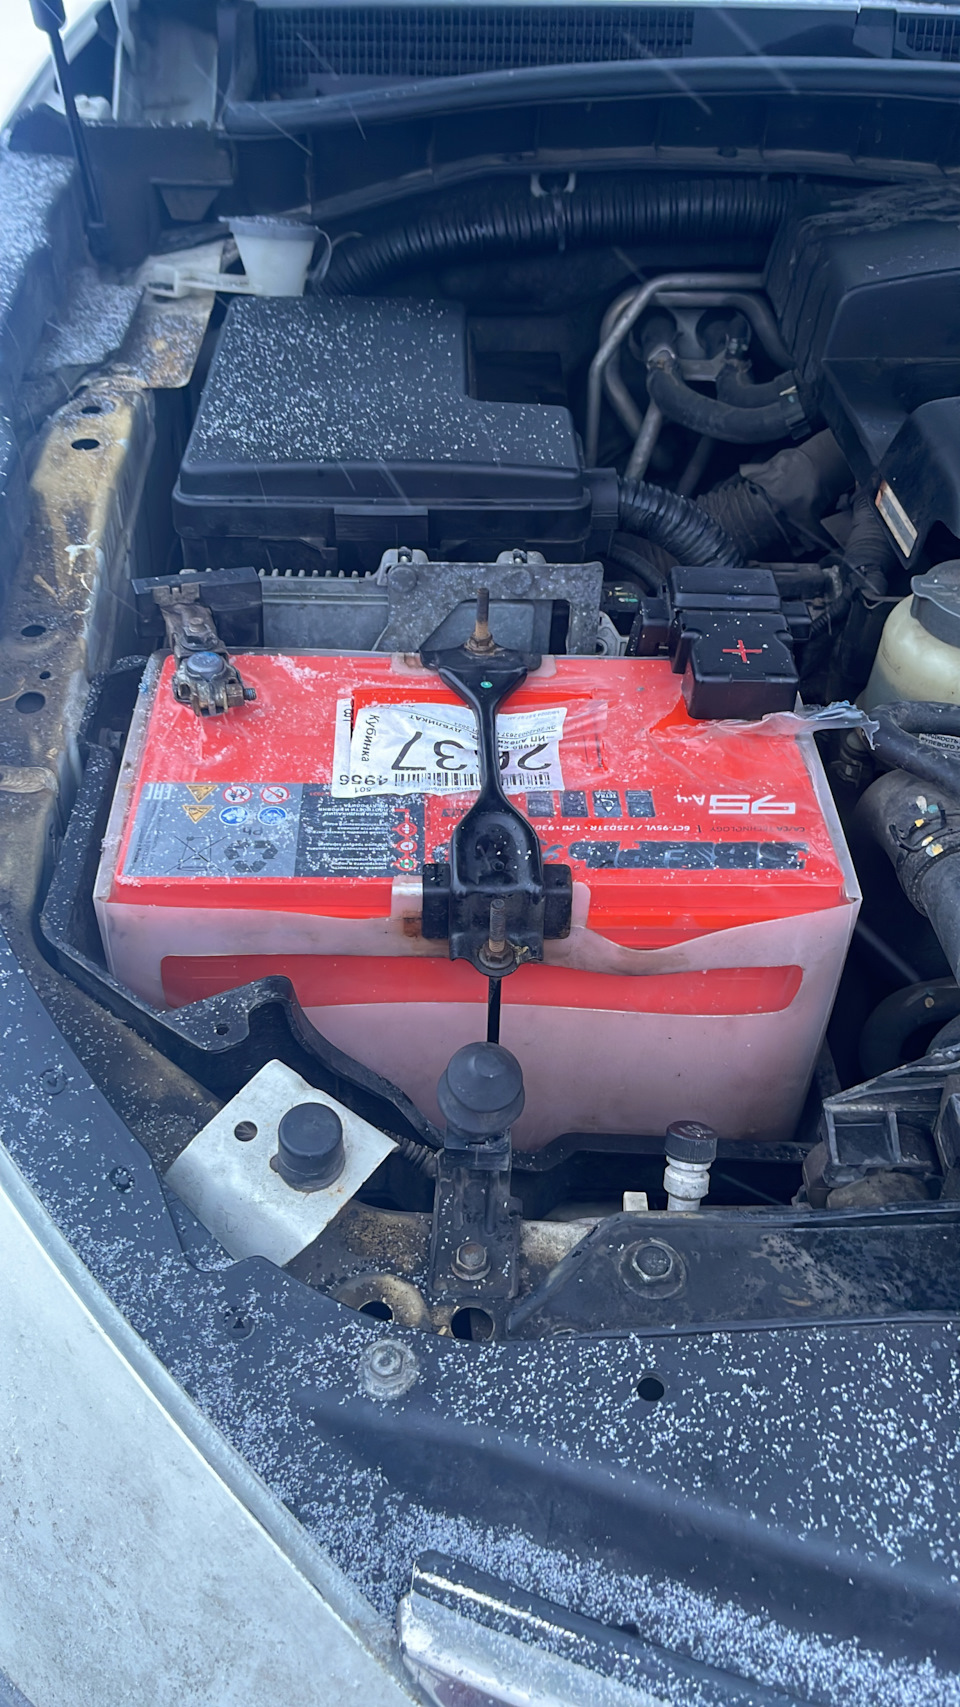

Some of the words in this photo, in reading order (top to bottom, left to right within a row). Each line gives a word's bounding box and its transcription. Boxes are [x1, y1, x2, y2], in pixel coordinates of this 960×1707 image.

[408, 716, 462, 733] ДУБЛИКАТ
[361, 714, 380, 763] Кубинка
[531, 735, 546, 743] ИП
[339, 775, 389, 786] 4956
[709, 795, 796, 815] 95
